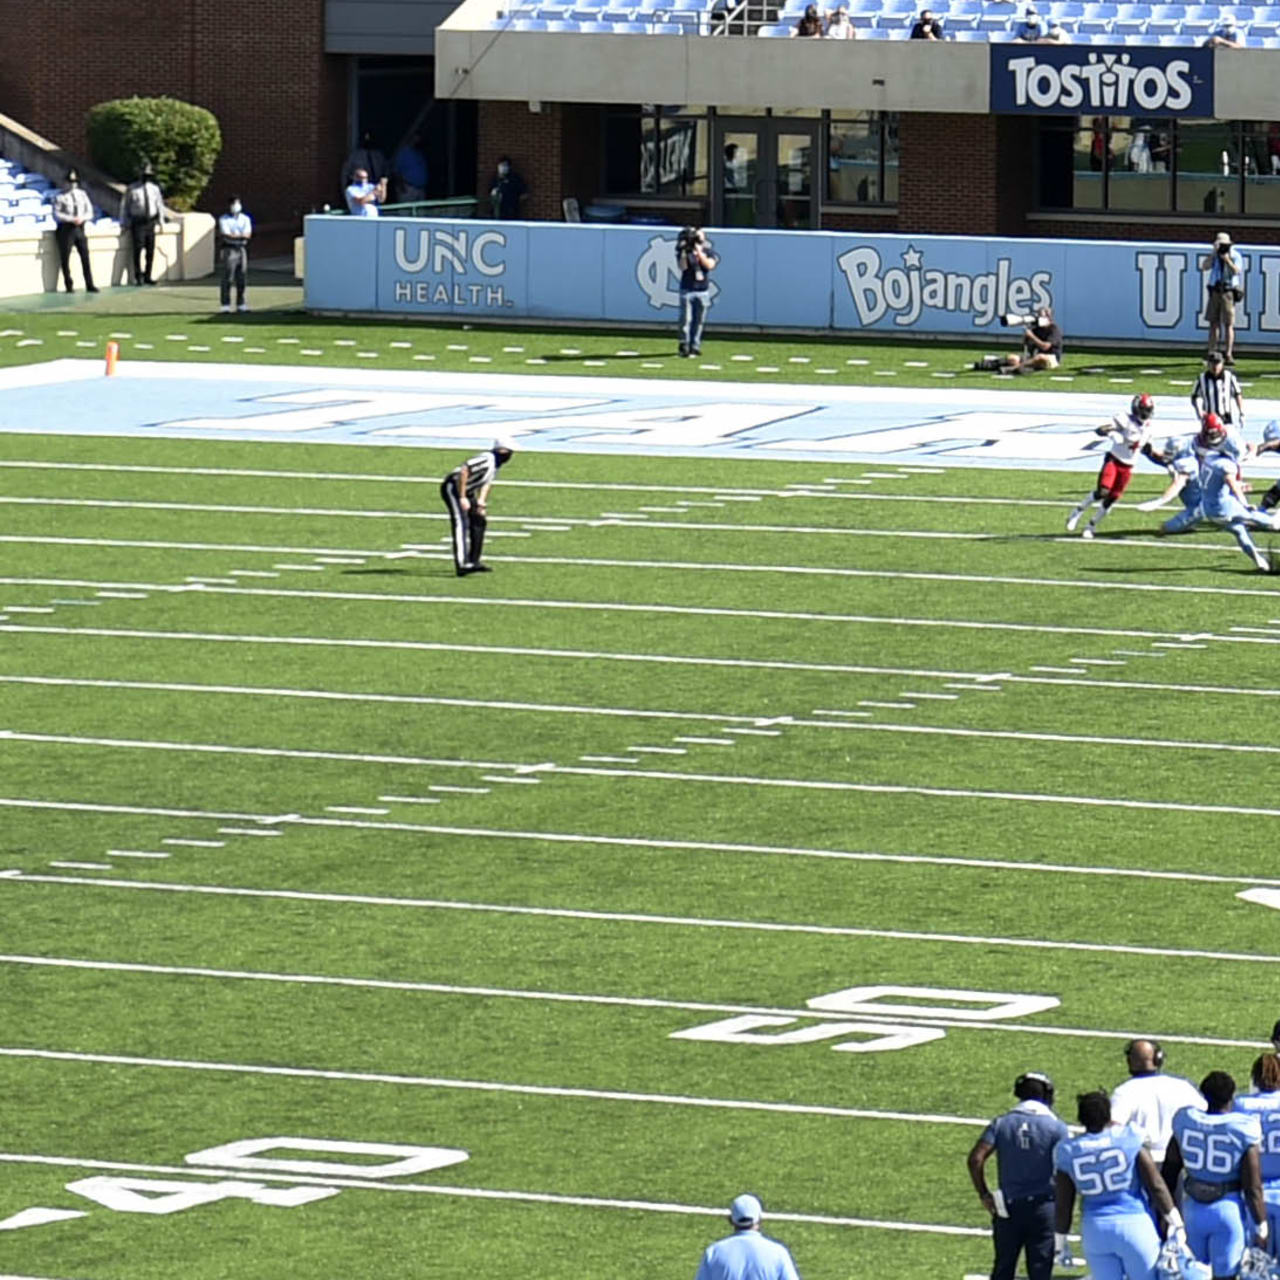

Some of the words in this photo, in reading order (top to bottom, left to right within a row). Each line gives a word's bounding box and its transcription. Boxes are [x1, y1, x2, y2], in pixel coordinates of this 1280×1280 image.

[395, 228, 506, 277] UNC
[395, 281, 506, 308] HEALTH
[837, 243, 1053, 327] Bojangles
[668, 983, 1062, 1053] 50
[64, 1135, 470, 1216] 40
[1072, 1148, 1131, 1195] 52
[1181, 1128, 1233, 1175] 56
